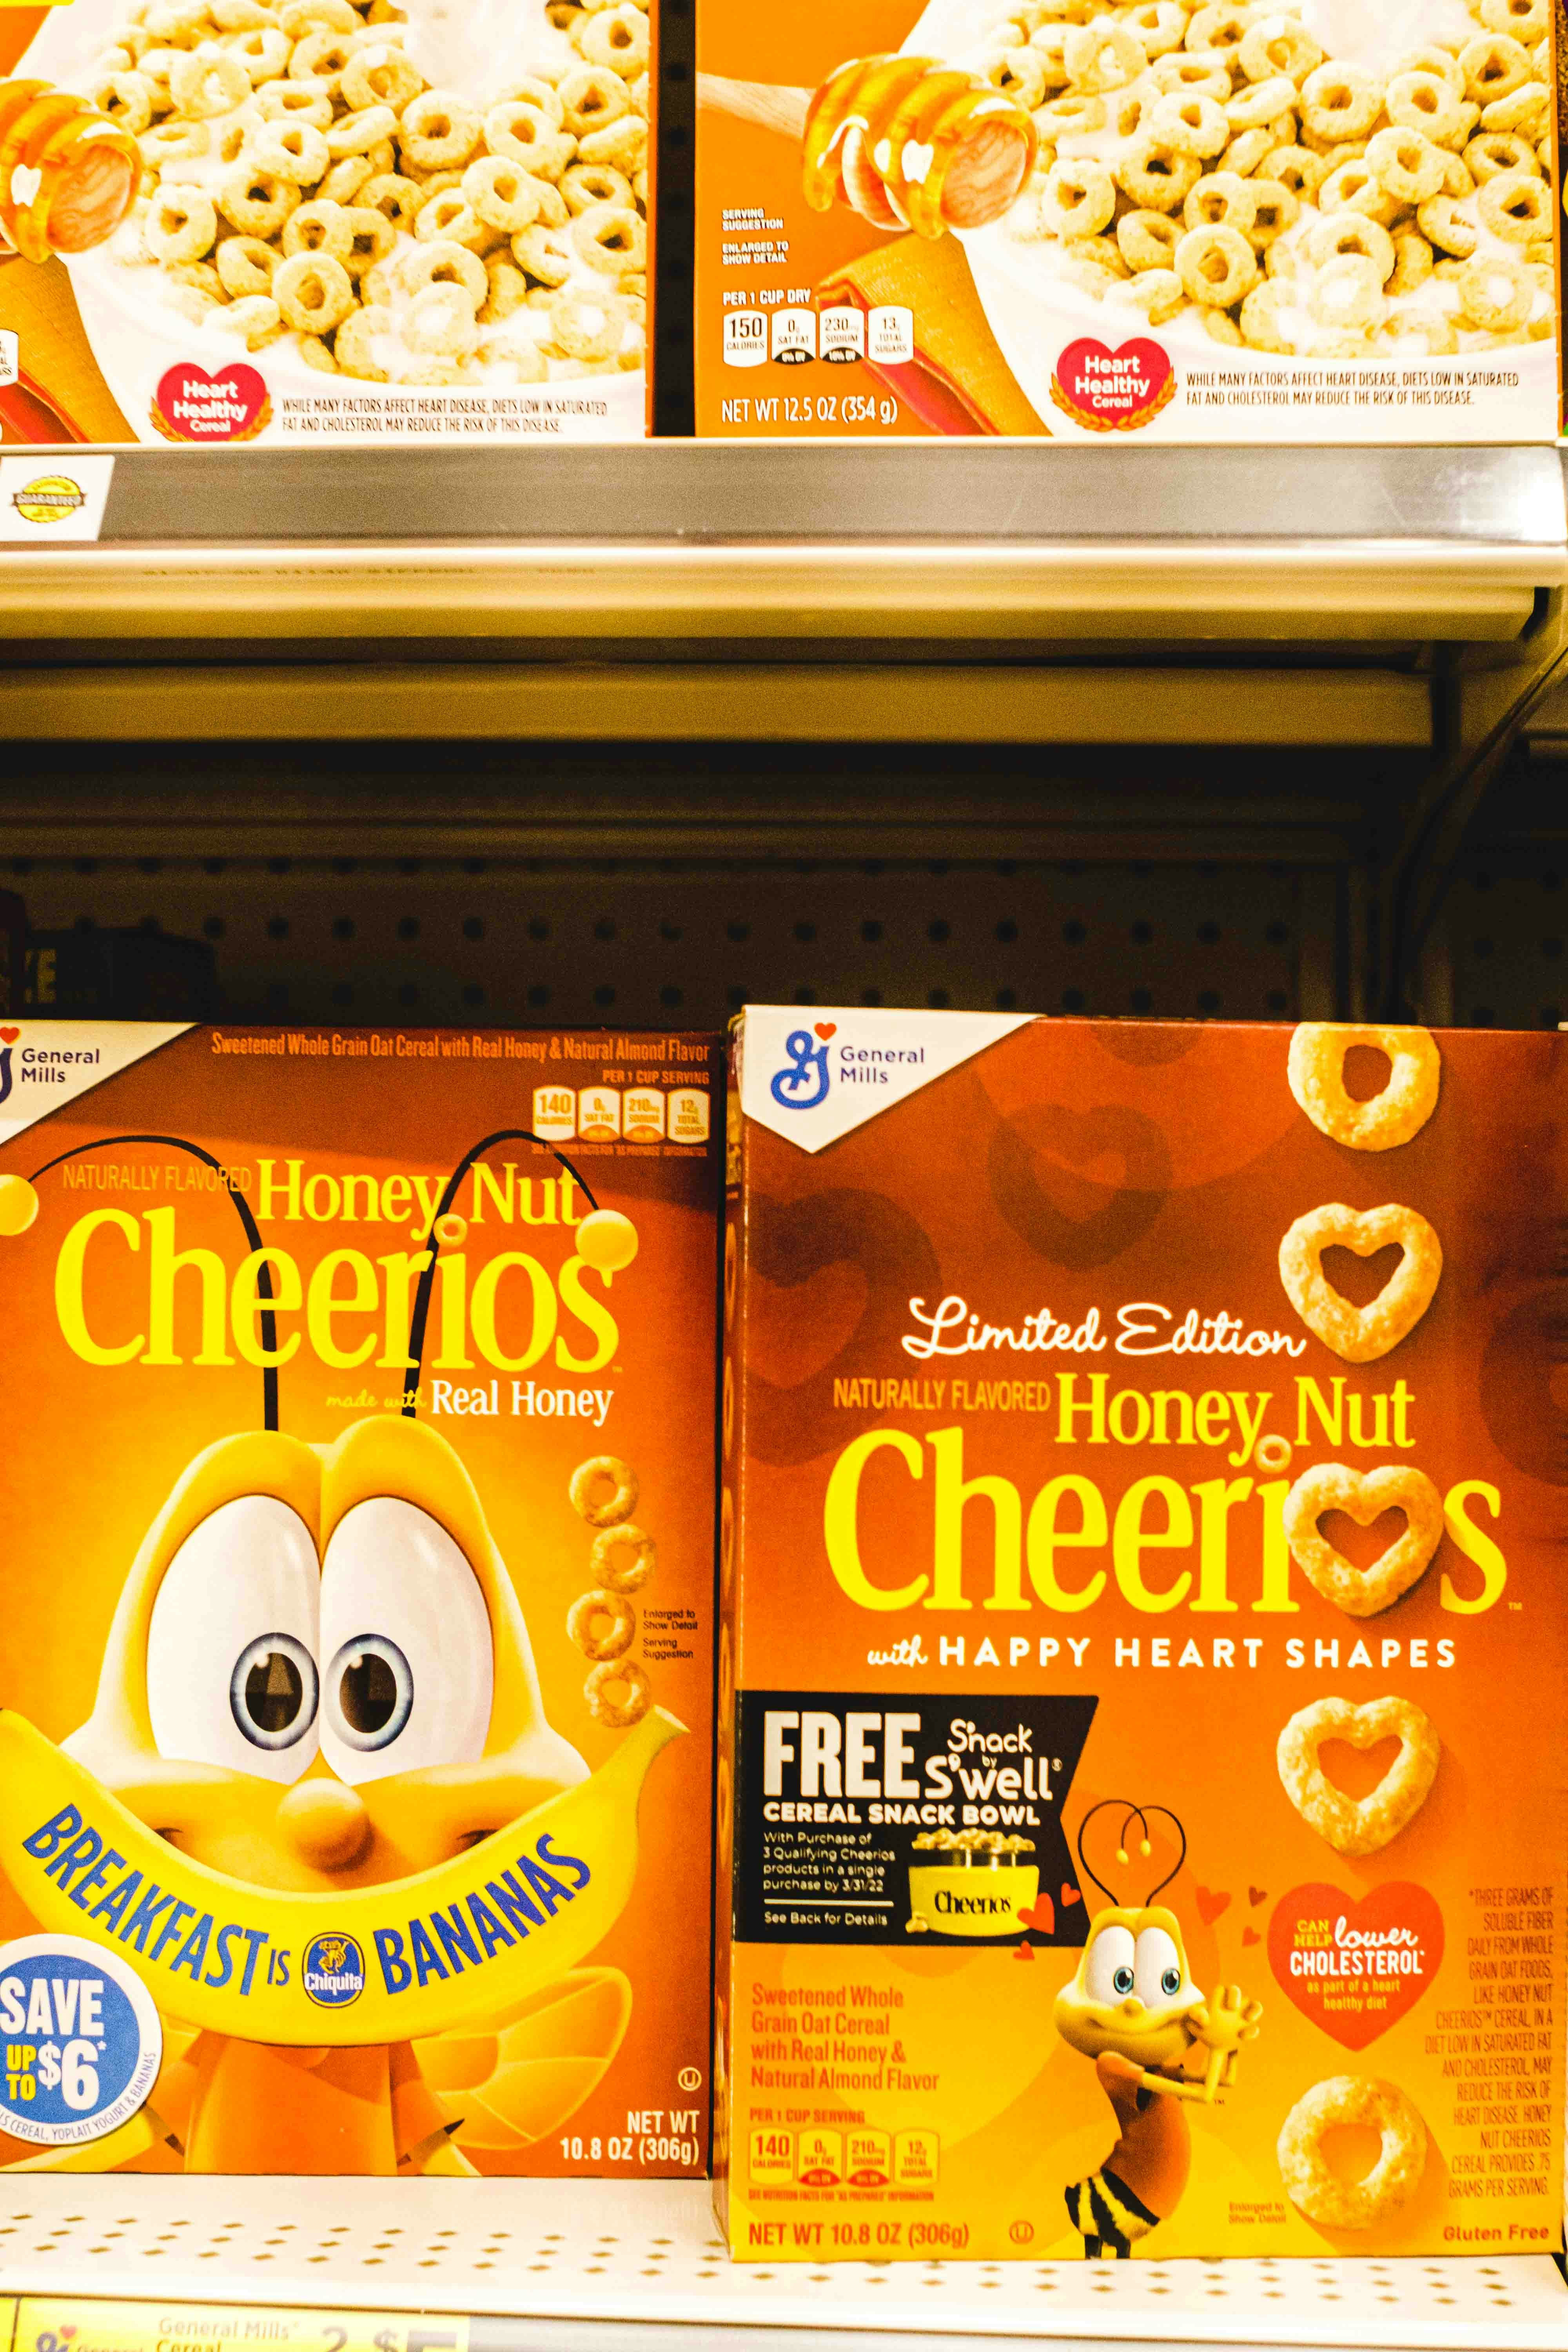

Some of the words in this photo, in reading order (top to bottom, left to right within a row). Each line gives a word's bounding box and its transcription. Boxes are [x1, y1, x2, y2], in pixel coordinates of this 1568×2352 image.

[722, 208, 764, 220] SERVING
[722, 219, 784, 231] SUGGESTION
[722, 242, 773, 254] ENLARGED
[776, 241, 789, 252] TO
[722, 254, 751, 265] SHOW
[754, 253, 787, 263] DETAIL
[724, 292, 746, 306] PER
[750, 292, 756, 305] 1
[760, 290, 784, 305] CUP
[788, 290, 811, 303] DRY
[729, 318, 762, 338] 150
[1085, 355, 1140, 374] Heart
[183, 380, 238, 398] Heart
[1074, 376, 1151, 397] Healthy
[1187, 373, 1214, 386] WHILE
[1220, 374, 1245, 386] MANY
[1249, 372, 1288, 386] FACTORS
[1292, 373, 1323, 386] AFFECT
[1327, 372, 1356, 386] HEART
[1403, 372, 1429, 386] DIETS
[1431, 372, 1451, 386] LOW
[1455, 373, 1464, 386] IN
[1467, 372, 1519, 387] SATURATED
[283, 399, 310, 413] WHILE
[315, 400, 339, 412] MANY
[344, 399, 382, 413] FACTORS
[385, 399, 415, 413] AFFECT
[419, 399, 446, 413] HEART
[493, 399, 518, 414] DIETS
[521, 400, 539, 414] LOW
[543, 400, 552, 413] IN
[556, 401, 607, 416] SATURATED
[1092, 395, 1132, 408] Cereal
[1187, 392, 1201, 405] FAT
[1206, 392, 1225, 405] AND
[1228, 392, 1289, 405] CHOLESTEROL
[1294, 392, 1312, 404] MAY
[1316, 392, 1349, 405] REDUCE
[1355, 391, 1369, 404] THE
[1374, 392, 1394, 405] RISK
[1397, 391, 1408, 405] OF
[1412, 391, 1431, 405] THIS
[173, 400, 248, 423] Healthy
[721, 399, 751, 423] NET
[755, 399, 779, 421] WT
[784, 397, 813, 421] 12.5
[817, 397, 837, 421] OZ
[842, 397, 876, 423] (354
[881, 397, 898, 425] g)
[190, 419, 231, 433] Cereal
[22, 1049, 100, 1063] General
[841, 1046, 924, 1063] General
[22, 1068, 65, 1083] Mills
[841, 1068, 888, 1084] Mills
[64, 1165, 160, 1191] NATURALLY
[166, 1166, 252, 1192] FLAVORED
[256, 1159, 451, 1241] Honey
[470, 1162, 583, 1226] Nut
[54, 1206, 619, 1374] Cheerios
[901, 1295, 1107, 1359] Limited
[1114, 1302, 1307, 1357] Edition
[326, 1390, 378, 1408] made
[385, 1387, 426, 1409] with
[431, 1380, 499, 1415] Real
[511, 1381, 614, 1427] Honey
[833, 1377, 946, 1410] NATURALLY
[951, 1380, 1051, 1412] FLAVORED
[1054, 1373, 1273, 1467] Honey
[1294, 1376, 1416, 1448] Nut
[824, 1427, 1507, 1614] Cheeris
[868, 1635, 928, 1667] with
[940, 1637, 1090, 1667] HAPPY
[1116, 1639, 1263, 1668] HEART
[1287, 1639, 1455, 1668] SHAPES
[764, 1711, 921, 1798] FREE
[982, 1754, 998, 1768] by
[765, 1803, 862, 1823] CEREAL
[869, 1805, 955, 1824] SNACK
[964, 1806, 1040, 1825] BOWL
[764, 1833, 794, 1843] With
[798, 1832, 856, 1844] Purchase
[860, 1833, 872, 1845] of
[764, 1847, 770, 1858] 3
[774, 1847, 837, 1862] Qualifying
[841, 1849, 895, 1861] Cheerios
[764, 1864, 819, 1876] products
[822, 1865, 834, 1875] in
[838, 1866, 845, 1875] a
[848, 1867, 885, 1878] single
[764, 1880, 820, 1892] purchase
[825, 1880, 839, 1893] by
[842, 1880, 884, 1893] 3/31/22
[22, 1803, 269, 1995] BREAKFAST
[267, 1949, 291, 1986] IS
[934, 1891, 1011, 1915] Cheerios
[373, 1833, 591, 1994] BANANAS
[765, 1912, 787, 1923] See
[791, 1913, 821, 1924] Back
[825, 1913, 841, 1925] for
[846, 1913, 887, 1926] Details
[1297, 1920, 1329, 1932] CAN
[1334, 1915, 1418, 1948] lower
[1294, 1933, 1333, 1947] HELP
[304, 1973, 364, 1995] Chiquita
[1308, 1982, 1319, 1993] as
[1323, 1981, 1345, 1996] part
[1349, 1979, 1359, 1993] of
[1363, 1982, 1369, 1993] a
[1373, 1980, 1400, 1992] heart
[0, 1977, 105, 2036] SAVE
[753, 1983, 846, 2007] Sweetened
[851, 1986, 904, 2008] Whole
[1324, 1996, 1363, 2012] healthy
[1367, 1997, 1387, 2010] diet
[752, 2011, 797, 2034] Grain
[802, 2012, 831, 2034] Oat
[835, 2013, 890, 2035] Cereal
[7, 2044, 36, 2071] UP
[751, 2040, 788, 2061] with
[792, 2038, 829, 2063] Real
[834, 2041, 887, 2067] Honey
[891, 2041, 906, 2063] &
[6, 2074, 36, 2101] TO
[752, 2067, 815, 2089] Natural
[818, 2067, 883, 2090] Almond
[887, 2068, 940, 2091] Flavor
[10, 2118, 49, 2141] CEREAL,
[52, 2123, 93, 2141] YOPLAIT
[93, 2102, 129, 2131] YOGURT
[126, 2096, 137, 2107] &
[133, 2051, 157, 2098] BANANAS
[628, 2111, 664, 2134] NET
[671, 2111, 700, 2133] WT
[561, 2138, 602, 2160] 10.8
[609, 2137, 633, 2160] OZ
[640, 2138, 699, 2165] (306g)
[750, 2223, 787, 2245] NET
[794, 2223, 824, 2245] WT
[832, 2224, 870, 2245] 10.8
[877, 2223, 902, 2245] OZ
[909, 2223, 969, 2249] (306g)
[1443, 2227, 1502, 2241] Gluten
[1509, 2225, 1550, 2240] Free
[158, 2316, 239, 2338] General
[244, 2320, 289, 2341] Mills
